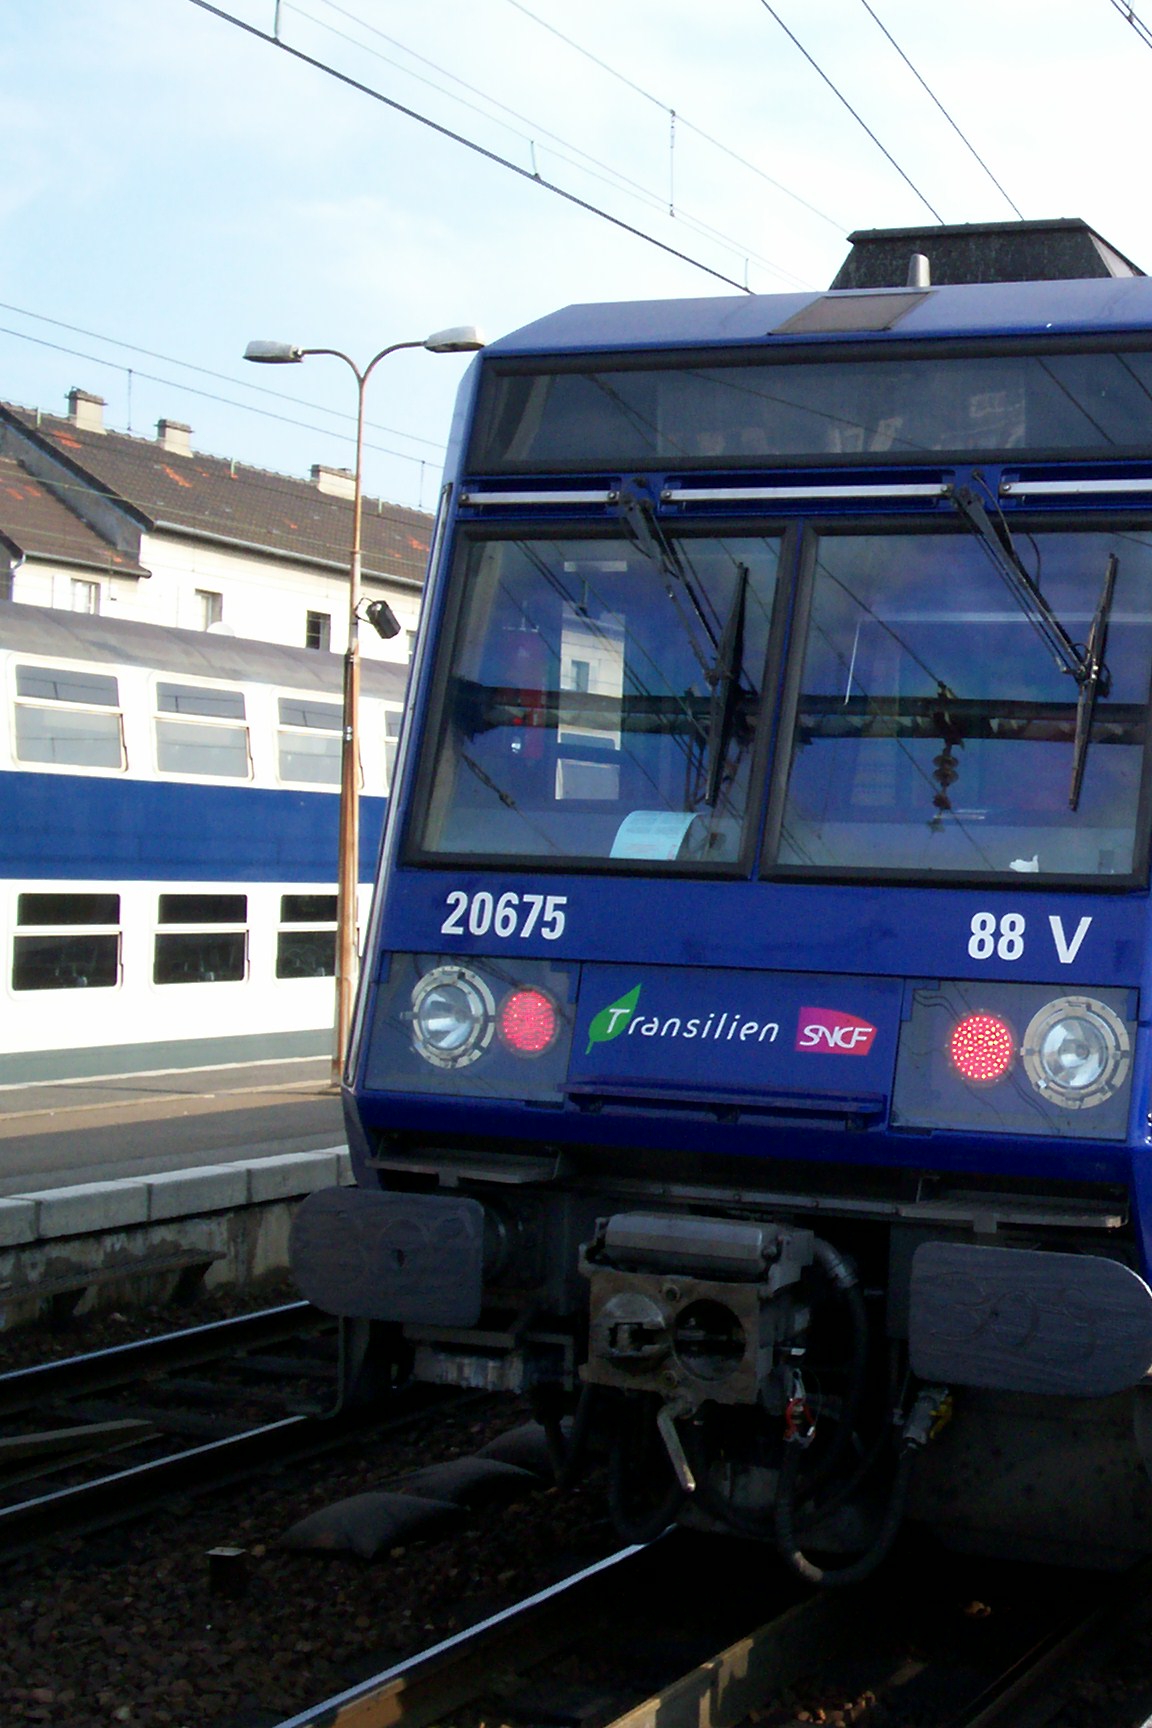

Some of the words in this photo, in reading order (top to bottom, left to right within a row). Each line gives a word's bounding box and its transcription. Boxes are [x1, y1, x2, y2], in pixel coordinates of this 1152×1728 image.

[441, 890, 568, 941] 20675
[967, 911, 1026, 961] 88
[1048, 914, 1093, 964] V
[606, 1007, 780, 1042] Transilien
[799, 1024, 873, 1049] SNCF
